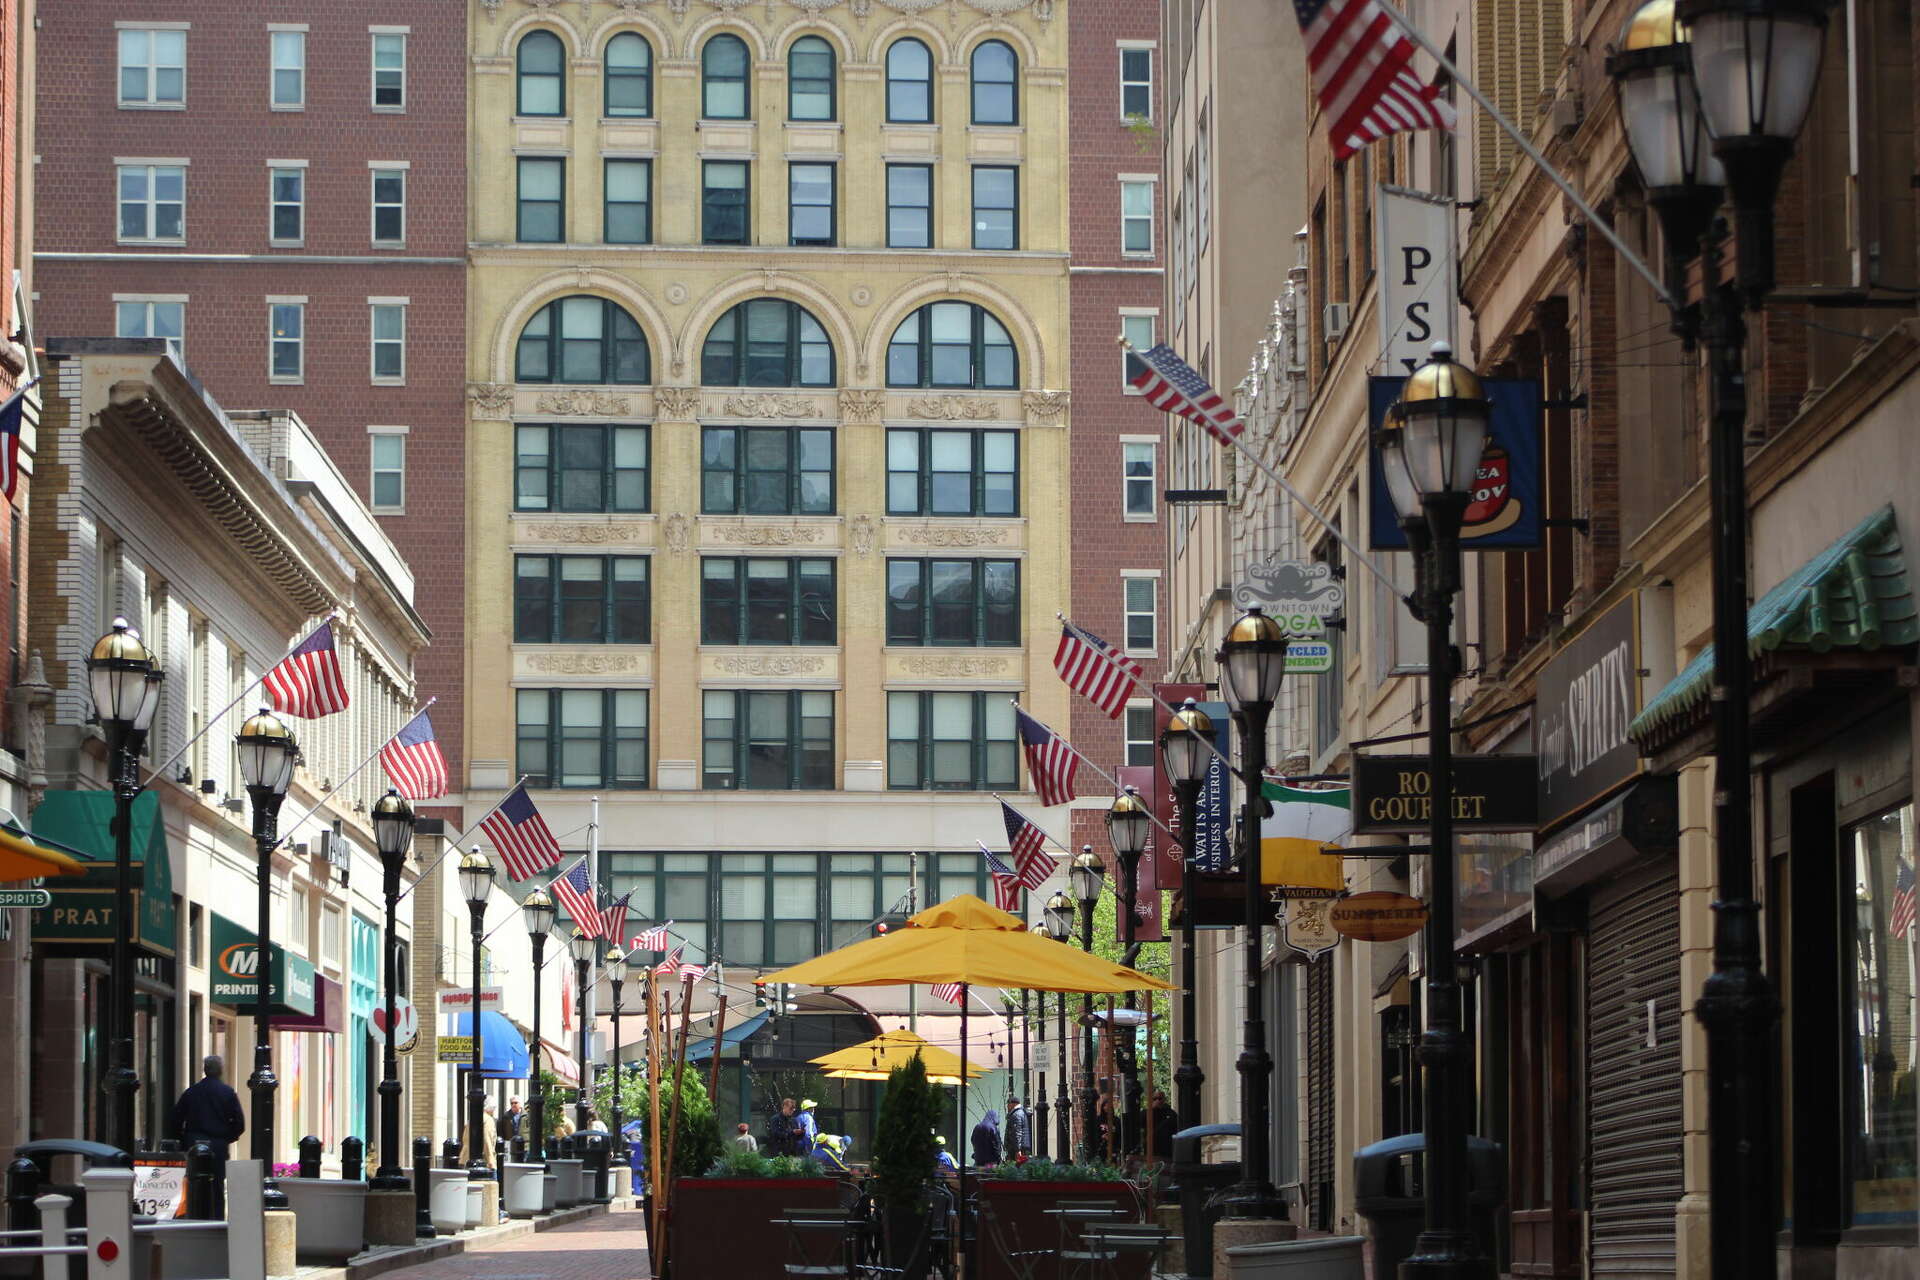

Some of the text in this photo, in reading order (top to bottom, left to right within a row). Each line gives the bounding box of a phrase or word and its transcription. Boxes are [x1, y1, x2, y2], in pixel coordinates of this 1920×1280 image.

[1475, 466, 1500, 479] EA
[1261, 603, 1330, 613] OWNTOWN
[1273, 614, 1320, 631] OGA
[1287, 646, 1328, 656] YCLED
[1569, 640, 1629, 777] SPIRITS
[1370, 796, 1485, 820] GOURET
[1211, 822, 1222, 871] USINESS
[0, 894, 44, 904] SPIRITS
[54, 908, 112, 925] PRAT
[215, 983, 276, 996] PRINTIG
